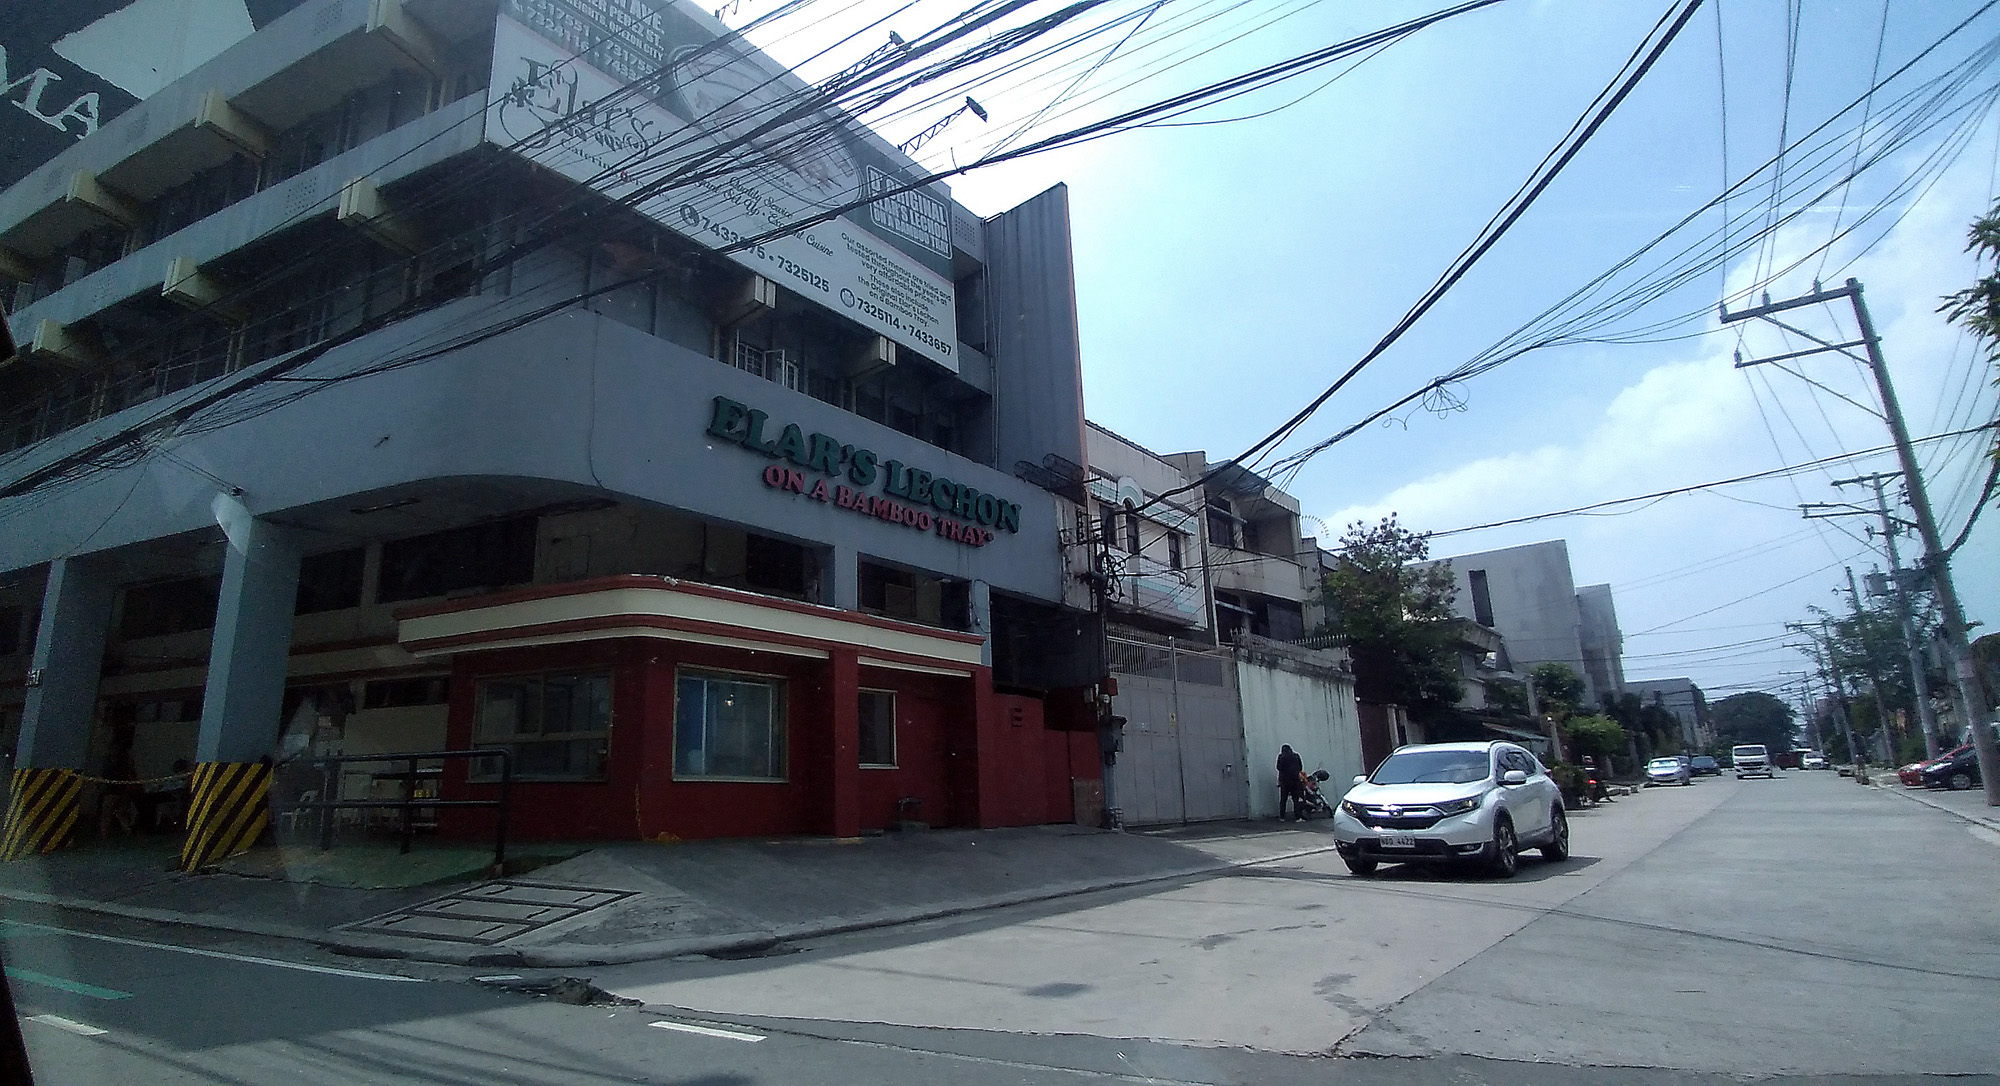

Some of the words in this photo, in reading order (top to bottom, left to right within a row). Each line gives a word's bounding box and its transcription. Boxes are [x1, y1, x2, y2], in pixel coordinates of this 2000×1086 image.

[630, 0, 665, 34] AVE.
[643, 43, 664, 61] CITY
[0, 45, 99, 139] LA
[562, 138, 617, 175] Caterin
[909, 209, 949, 242] LECHON
[806, 233, 834, 257] Cuisine
[777, 255, 831, 293] 7325125
[841, 232, 855, 244] Our
[856, 241, 888, 263] assorted
[888, 260, 911, 278] menus
[912, 274, 924, 285] are
[924, 280, 939, 294] tried
[939, 290, 951, 302] and
[846, 243, 870, 261] tested
[871, 257, 910, 283] throughout
[910, 279, 922, 291] the
[922, 287, 939, 302] years
[940, 298, 948, 306] at
[861, 260, 877, 275] very
[878, 269, 914, 294] affordable
[858, 275, 870, 287] the
[870, 282, 898, 302] Original
[916, 308, 940, 325] Lechon
[868, 290, 879, 300] on
[884, 297, 913, 318] Bamboo
[869, 273, 890, 290] These
[890, 286, 905, 298] also
[905, 292, 929, 312] include
[856, 297, 901, 330] 7325114
[908, 324, 952, 356] 7433657
[706, 395, 878, 486] ELAR'S
[883, 459, 1021, 535] LECHON
[763, 464, 806, 494] ON
[809, 478, 831, 504] A
[835, 485, 934, 532] BAMBOO
